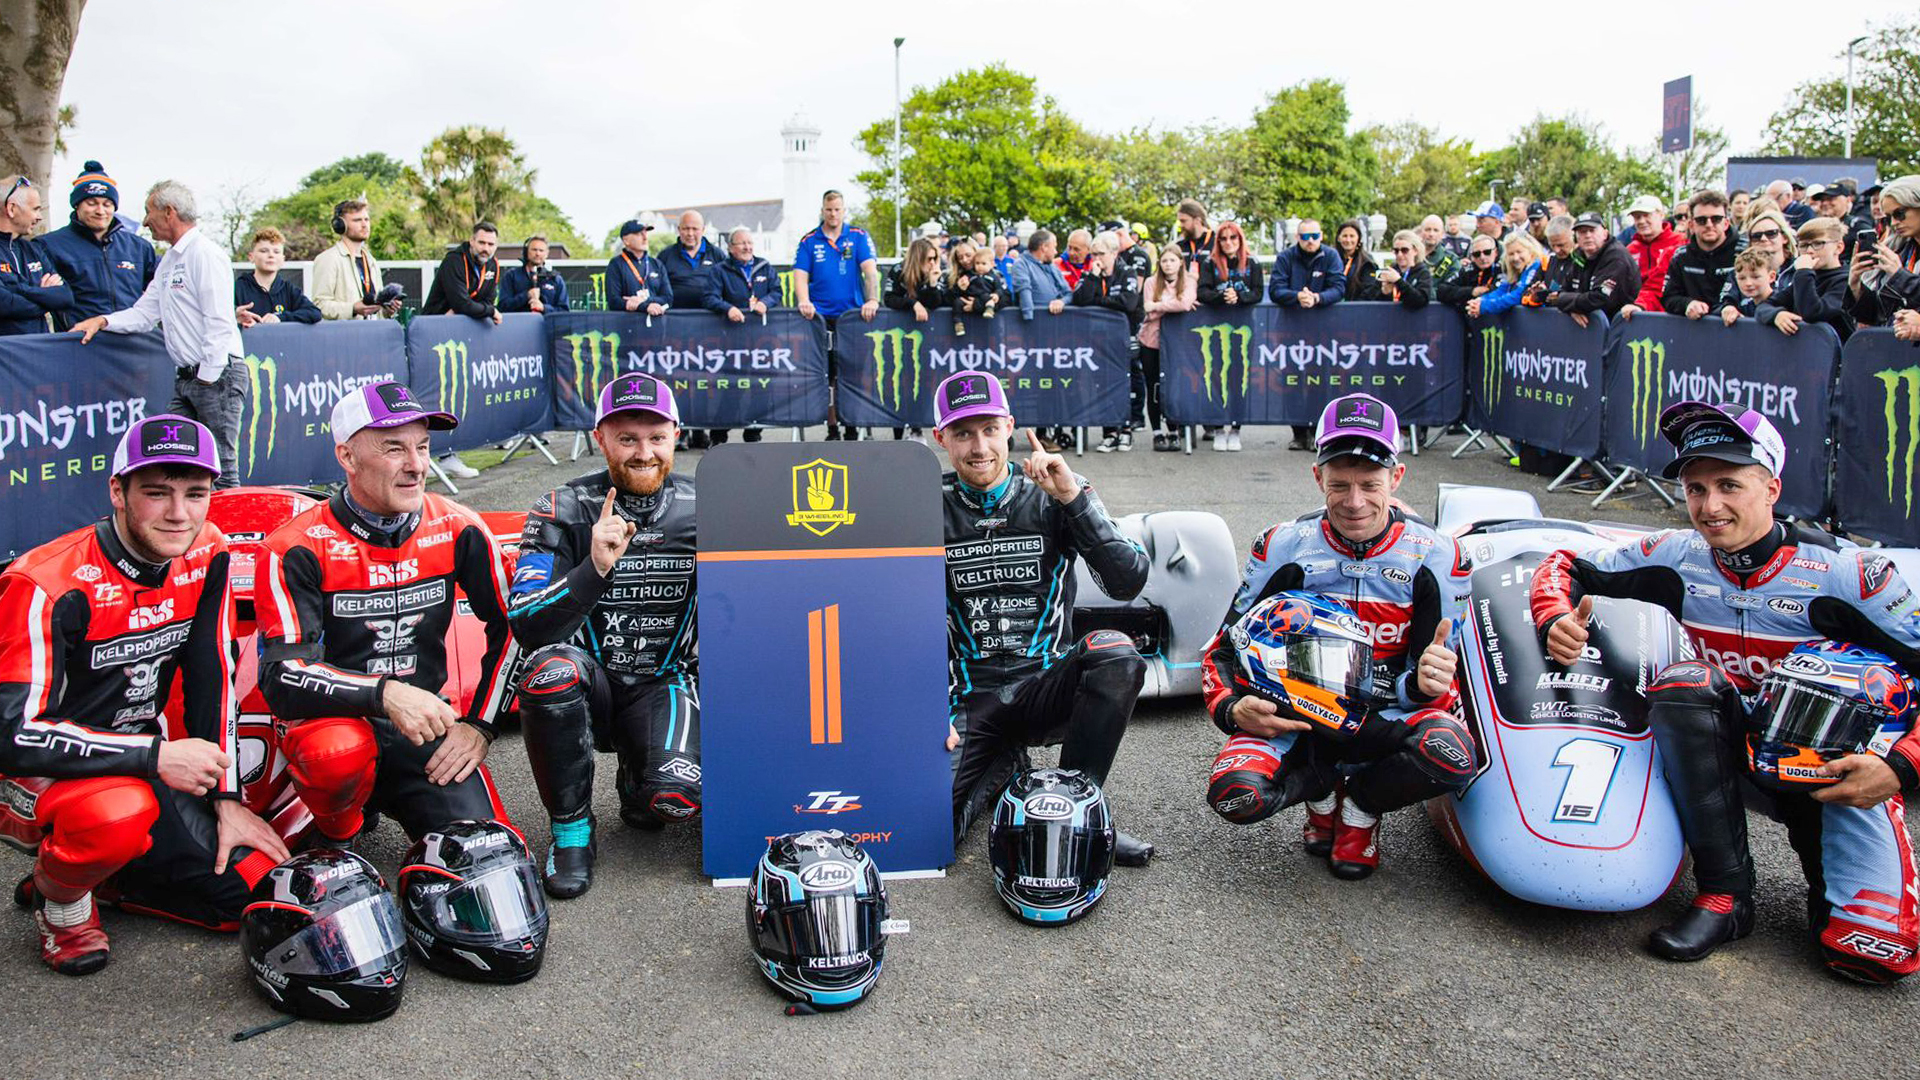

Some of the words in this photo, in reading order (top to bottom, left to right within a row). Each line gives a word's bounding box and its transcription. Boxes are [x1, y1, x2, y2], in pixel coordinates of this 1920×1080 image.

[627, 345, 797, 375] MONSTER
[929, 343, 1099, 372] MONSTER
[1258, 339, 1434, 370] MONSTER
[472, 353, 544, 389] MONSTER
[1504, 346, 1589, 389] MONSTER
[664, 377, 772, 389] NERGY
[1002, 378, 1072, 389] ERGY
[1286, 375, 1405, 386] ENERGY
[485, 386, 538, 406] ENERGY
[616, 394, 654, 403] HOOSIER
[951, 393, 987, 406] HOOSIER
[1515, 385, 1574, 408] ENERGY
[1668, 367, 1800, 426] MONSTER
[0, 396, 147, 460] ONSTER
[1339, 416, 1380, 427] HOOSIER
[147, 443, 196, 452] HOOSIER
[9, 454, 106, 486] NERG
[1403, 534, 1434, 546] MOTUL
[947, 540, 1040, 559] KELPROPERTIES
[614, 559, 693, 572] LPROPERTIES
[1680, 564, 1711, 574] HONDA
[1792, 558, 1828, 572] MOTUL
[956, 565, 1036, 585] KELTRUCK
[1383, 568, 1409, 581] Arai
[337, 586, 443, 612] KELPROPERTIES
[991, 597, 1037, 609] AZIONE
[1773, 599, 1800, 612] Arai
[1480, 599, 1498, 638] Powered
[96, 626, 190, 662] KELPROPERTIES
[1487, 637, 1499, 652] by
[1491, 652, 1508, 685] Honda
[1783, 654, 1826, 672] Arai
[530, 664, 576, 688] RST
[1262, 688, 1271, 696] OF
[1272, 693, 1290, 705] MAN
[1531, 701, 1567, 712] SWT
[1531, 711, 1560, 719] VEHICLE
[1561, 711, 1598, 721] LOGISTICS
[1600, 716, 1627, 728] LIMITED
[658, 757, 702, 782] RS
[1553, 740, 1624, 821] 1
[1028, 798, 1067, 813] Arai
[1561, 804, 1594, 818] 15
[463, 831, 509, 851] NOLAN
[851, 832, 892, 845] OPHY
[315, 861, 364, 883] NOLAN
[807, 861, 848, 881] Arai
[422, 882, 450, 896] X-804
[1018, 876, 1075, 888] KELTRUCK
[809, 950, 871, 969] KELTRUCK
[250, 956, 290, 990] NOLAN
